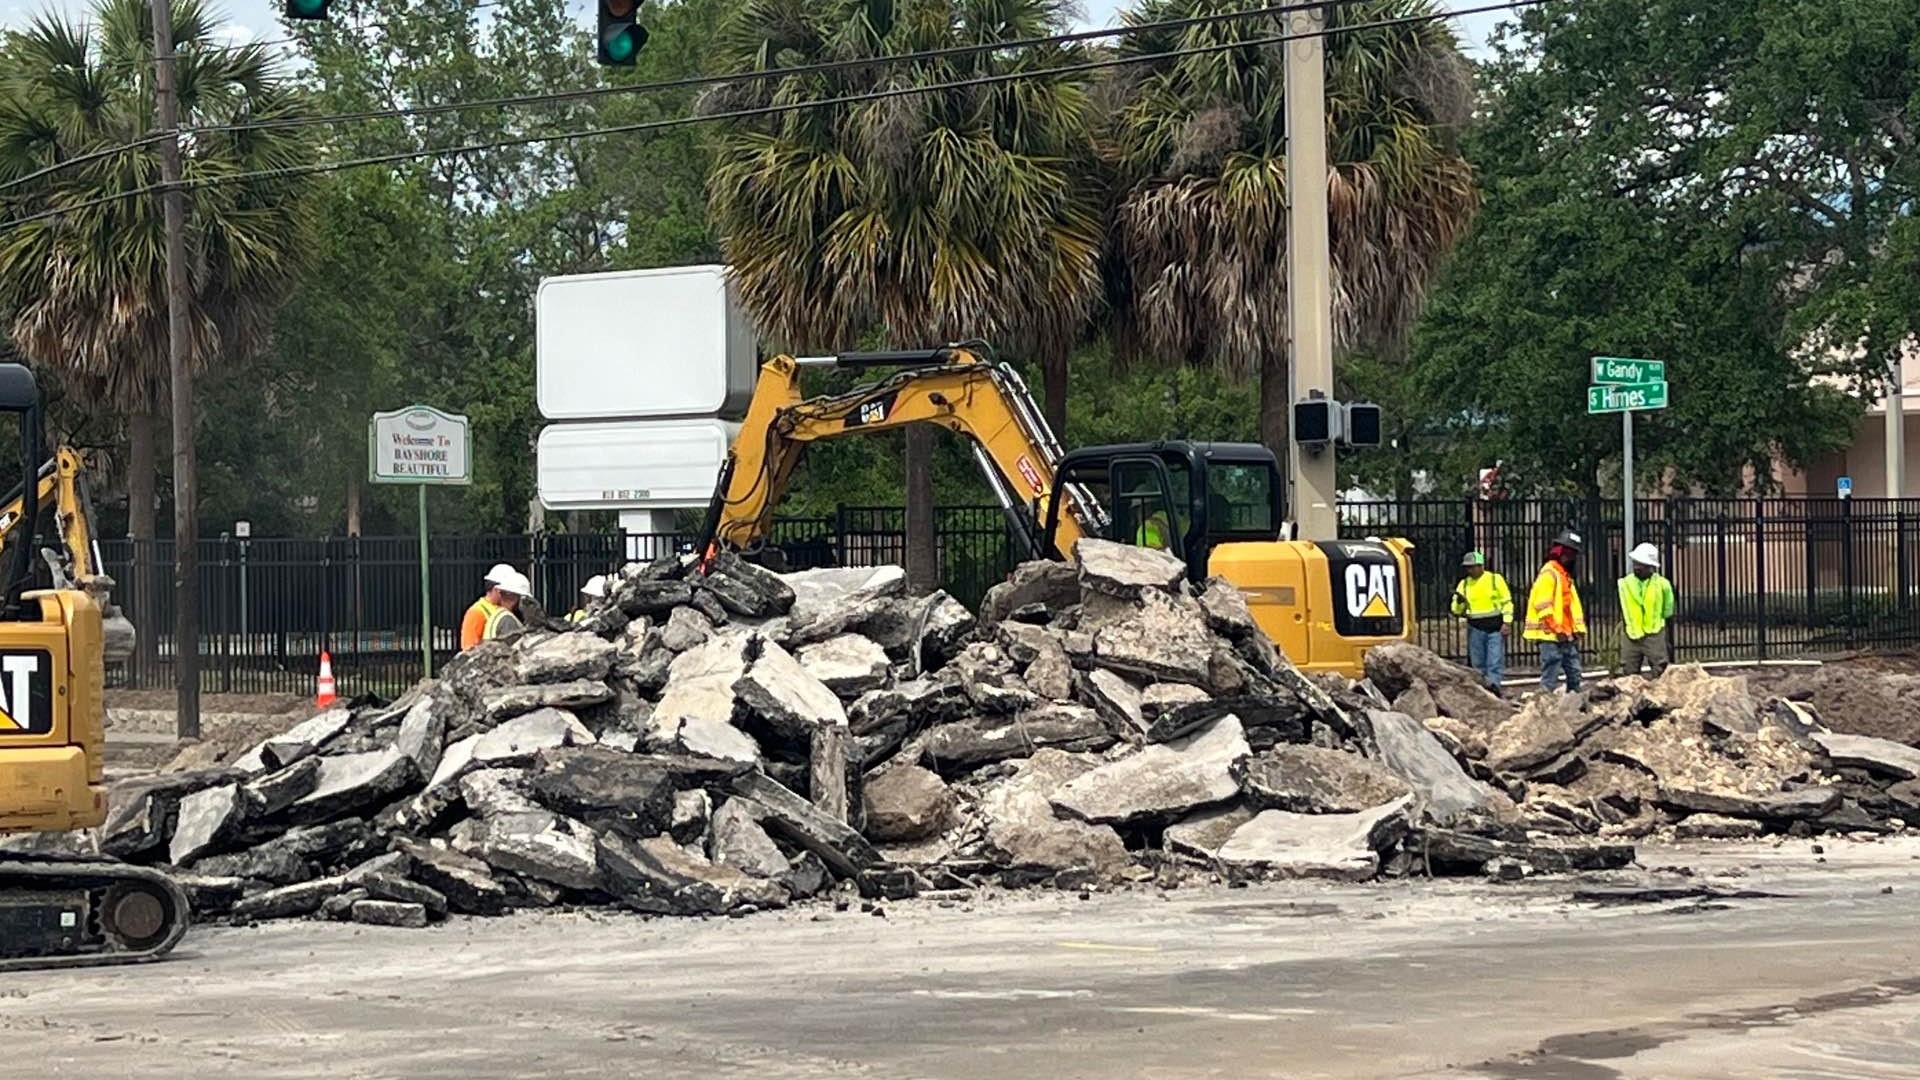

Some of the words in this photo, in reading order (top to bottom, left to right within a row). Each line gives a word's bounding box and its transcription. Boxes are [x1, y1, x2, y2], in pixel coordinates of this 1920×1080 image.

[1607, 360, 1643, 382] Gandy
[1590, 392, 1598, 407] S
[1602, 387, 1646, 408] Himes
[861, 401, 885, 424] CAT
[392, 432, 434, 446] Welcome
[437, 434, 451, 447] To
[394, 448, 449, 461] BAYSHORE
[393, 462, 449, 475] BEAUTIFUL
[1345, 563, 1396, 618] CAT
